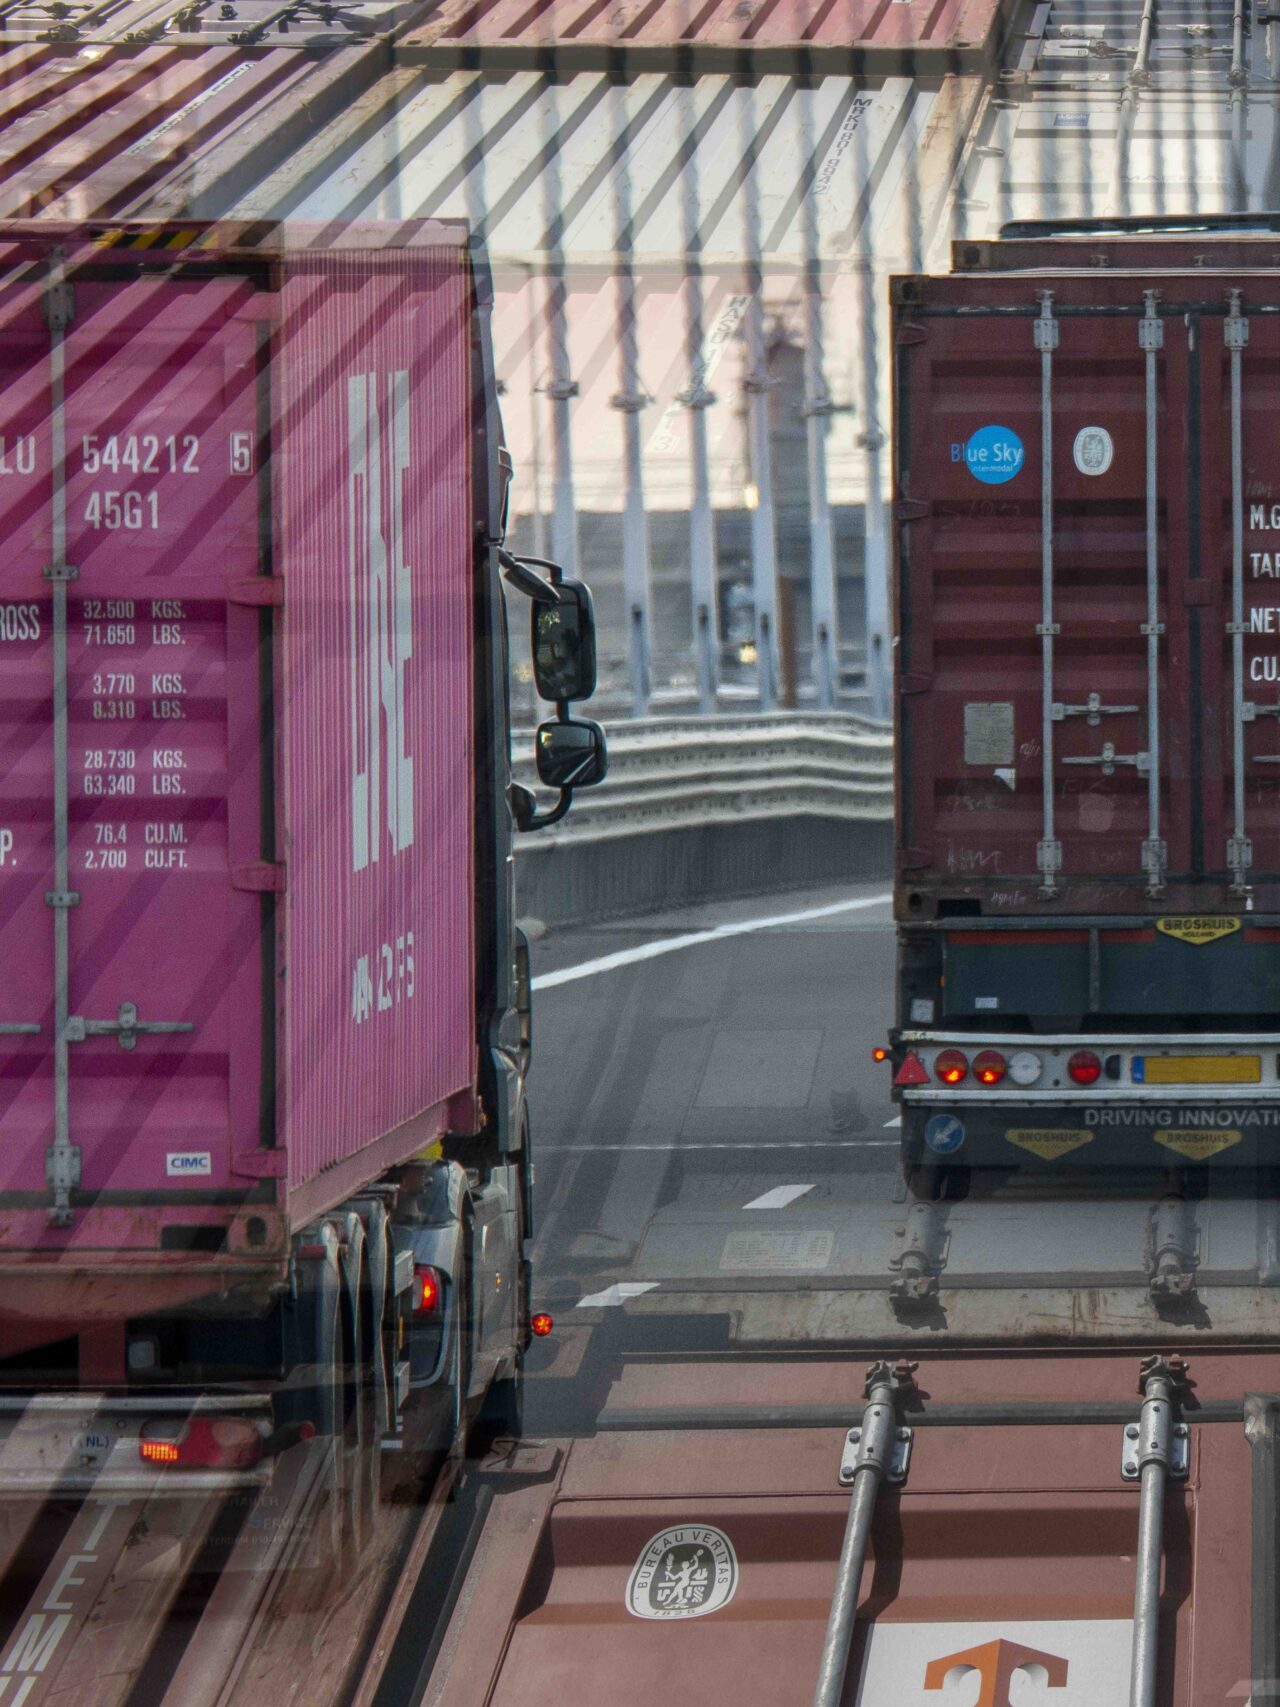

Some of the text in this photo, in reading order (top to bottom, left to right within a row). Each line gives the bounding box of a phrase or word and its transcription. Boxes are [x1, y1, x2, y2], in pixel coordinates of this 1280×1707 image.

[82, 434, 200, 474] 544212
[231, 432, 252, 475] 5
[951, 442, 1023, 466] Blue Sky
[84, 490, 159, 530] 45G1
[152, 600, 187, 619] KGS.
[152, 624, 187, 645] LBS.
[152, 673, 188, 694] KGS.
[152, 700, 187, 719] LBS.
[152, 749, 188, 769] KGS.
[152, 774, 187, 795] LBS.
[95, 823, 127, 845] 76.4
[144, 823, 188, 845] CU.M.
[144, 849, 188, 869] CU.FT.
[1163, 919, 1236, 931] BROSHUIS
[1084, 1108, 1172, 1127] DRIVING
[1016, 1131, 1082, 1143] BROSHUIS
[1166, 1132, 1230, 1144] BROSHUIS
[170, 1156, 209, 1169] CIMC
[637, 1531, 729, 1589] BUREAU VERITAS
